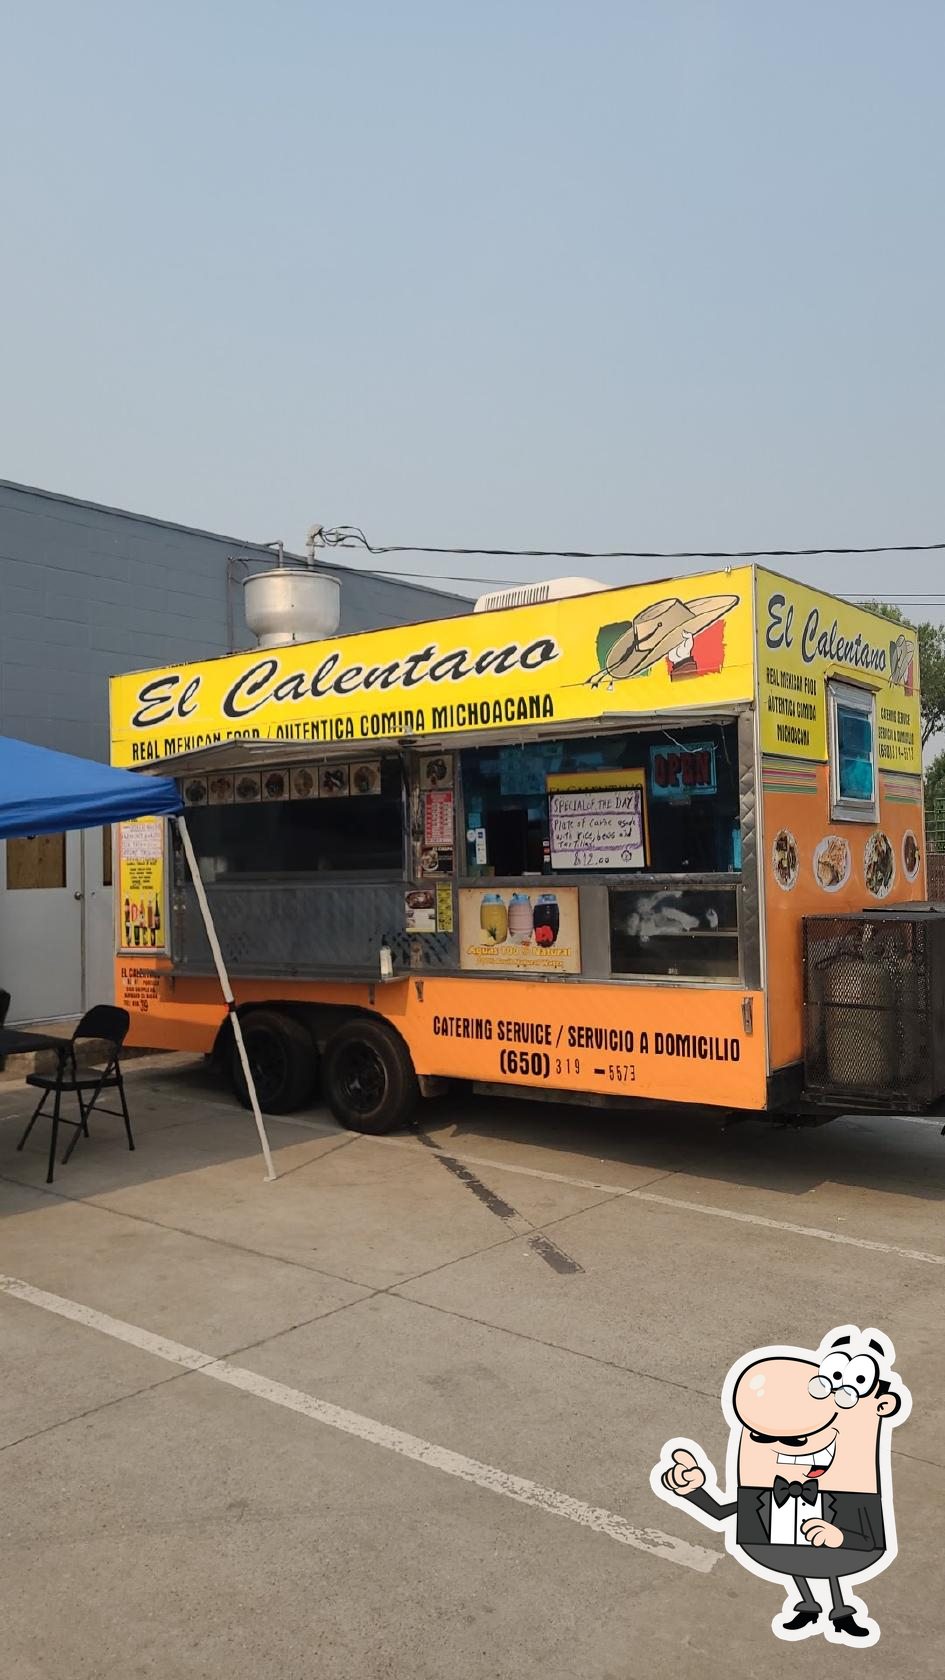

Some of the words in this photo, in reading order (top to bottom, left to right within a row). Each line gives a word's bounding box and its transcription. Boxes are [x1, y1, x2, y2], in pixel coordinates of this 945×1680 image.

[766, 594, 794, 649] El
[801, 608, 887, 672] Calentano
[131, 675, 201, 729] El
[223, 638, 560, 718] Calentano
[767, 667, 780, 686] REAL
[132, 739, 160, 761] REAL
[276, 716, 354, 739] AUTENTICA
[360, 709, 425, 737] COMIDA
[432, 693, 554, 729] MICHOACANA
[654, 750, 710, 788] OPEN
[554, 798, 587, 813] SPECIAL
[598, 799, 611, 810] THE
[615, 797, 633, 810] DAY
[554, 820, 574, 831] Plate
[577, 817, 586, 828] of
[467, 945, 499, 956] Aguas
[531, 946, 571, 957] Natural
[433, 1015, 493, 1041] CATERING
[497, 1019, 552, 1046] SERVICE
[555, 1025, 564, 1049] /
[568, 1025, 634, 1053] SERVICIO
[639, 1031, 649, 1054] A
[655, 1032, 740, 1062] DOMICILIO
[500, 1049, 550, 1079] (650)
[555, 1058, 581, 1075] 319
